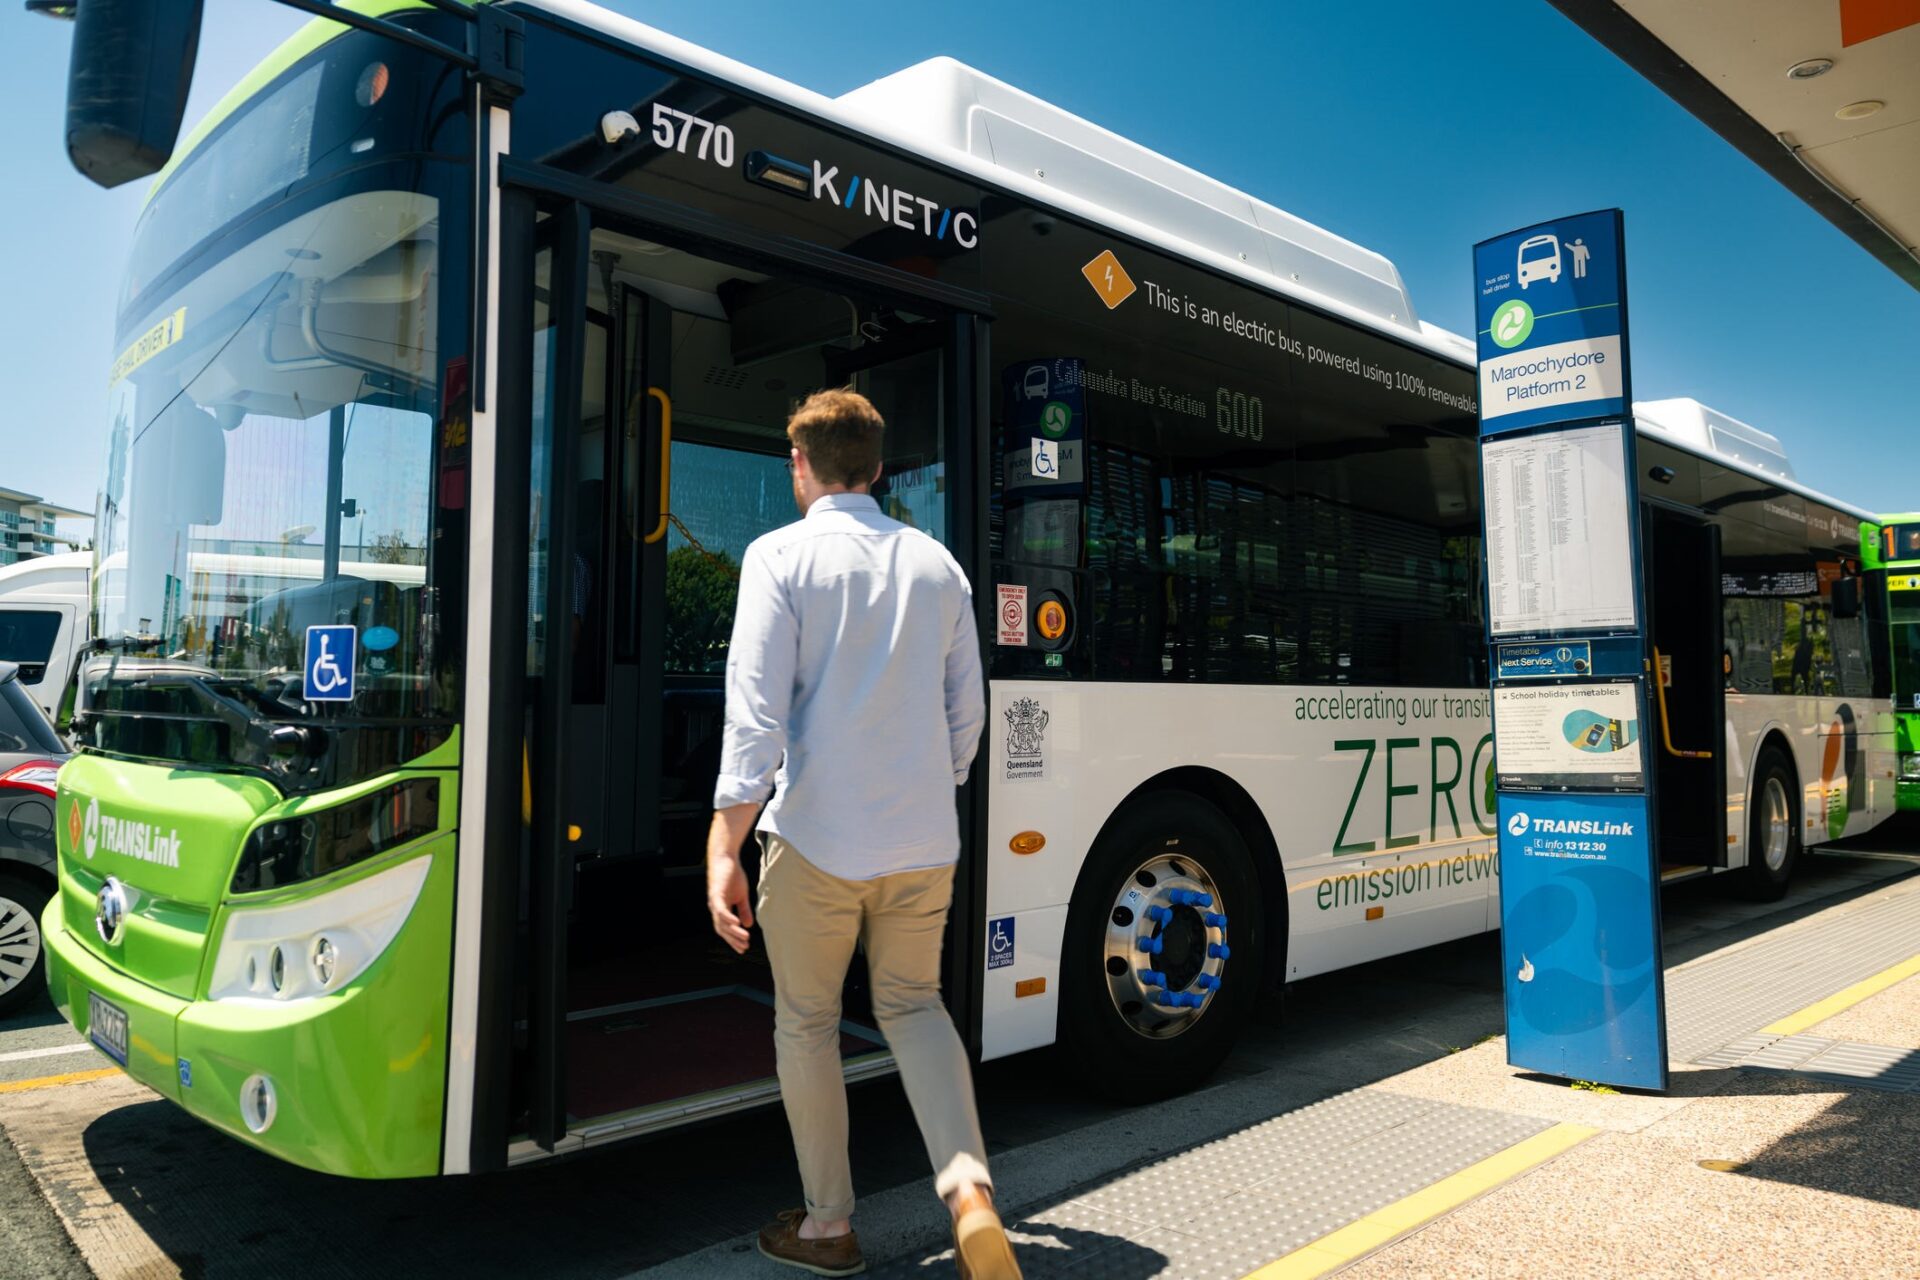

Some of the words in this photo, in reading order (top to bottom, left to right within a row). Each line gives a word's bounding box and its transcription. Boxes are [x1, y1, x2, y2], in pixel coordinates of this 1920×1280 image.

[652, 102, 734, 168] 5770
[1497, 273, 1510, 284] stop
[1144, 280, 1180, 315] This
[1184, 293, 1198, 319] is
[1201, 304, 1220, 328] an
[1222, 311, 1276, 348] electric
[1279, 328, 1305, 359] bus,
[1308, 344, 1361, 377] powered
[1363, 358, 1393, 390] using
[1395, 370, 1426, 398] 100%
[1428, 383, 1477, 415] renewable
[1491, 351, 1605, 384] Maroochydore
[1055, 358, 1128, 398] Caloundra
[1131, 378, 1156, 406] Bus
[1159, 386, 1206, 419] Station
[1506, 378, 1570, 401] Platform
[1575, 374, 1586, 390] 2
[1216, 387, 1263, 442] 600
[1501, 659, 1520, 667] Next
[1520, 657, 1553, 666] Service
[1502, 647, 1540, 656] Timetable
[1510, 691, 1537, 700] School
[1538, 690, 1569, 700] holiday
[1571, 688, 1620, 698] timetables
[1295, 689, 1406, 726] accelerating
[1412, 697, 1438, 719] our
[1006, 759, 1043, 770] Queensland
[1006, 770, 1043, 779] Government
[1533, 819, 1634, 836] TRANSLink
[100, 815, 182, 868] TRANSLink
[1545, 839, 1564, 850] info
[1565, 841, 1577, 850] 13
[1578, 842, 1592, 851] 12
[1592, 842, 1606, 851] 30
[1534, 851, 1606, 860] www.translink.com.au
[1317, 855, 1431, 910] emission
